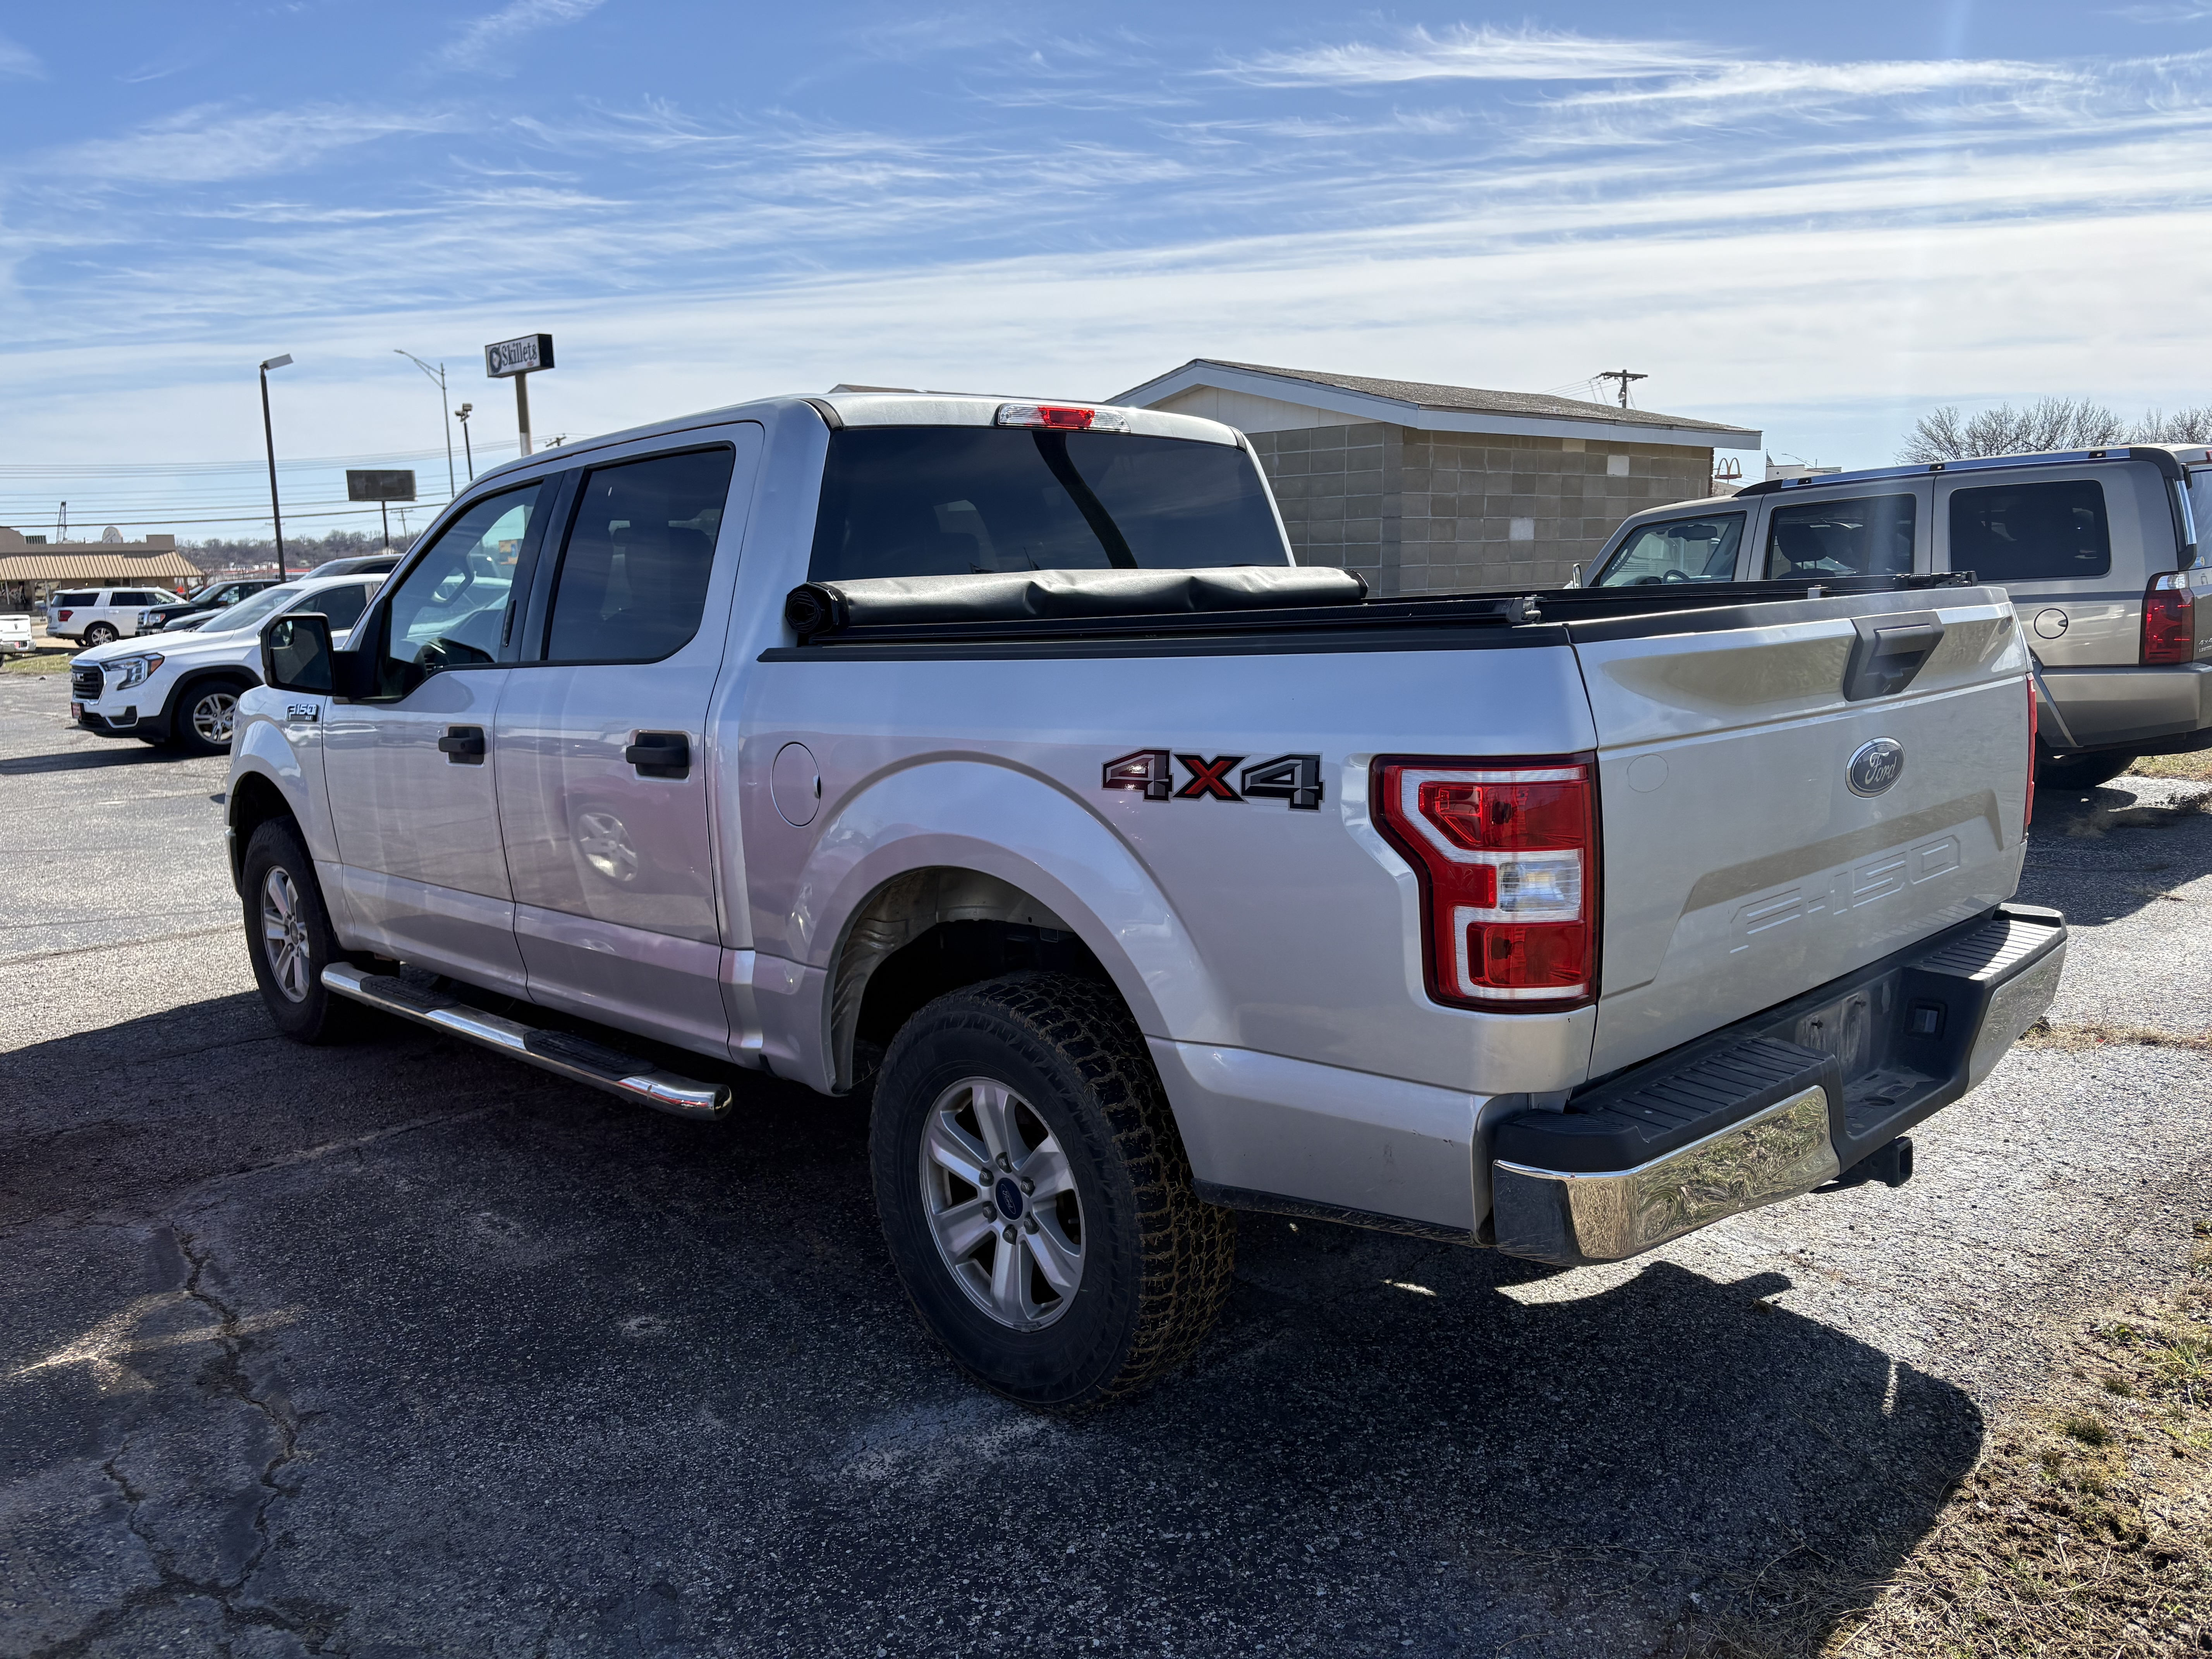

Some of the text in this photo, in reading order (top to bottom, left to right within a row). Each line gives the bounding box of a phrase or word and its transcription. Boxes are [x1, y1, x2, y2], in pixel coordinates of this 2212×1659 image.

[502, 342, 538, 366] Skillets
[1865, 750, 1897, 785] Ford
[1730, 834, 1961, 953] F-150
[1002, 1190, 1013, 1209] Ford
